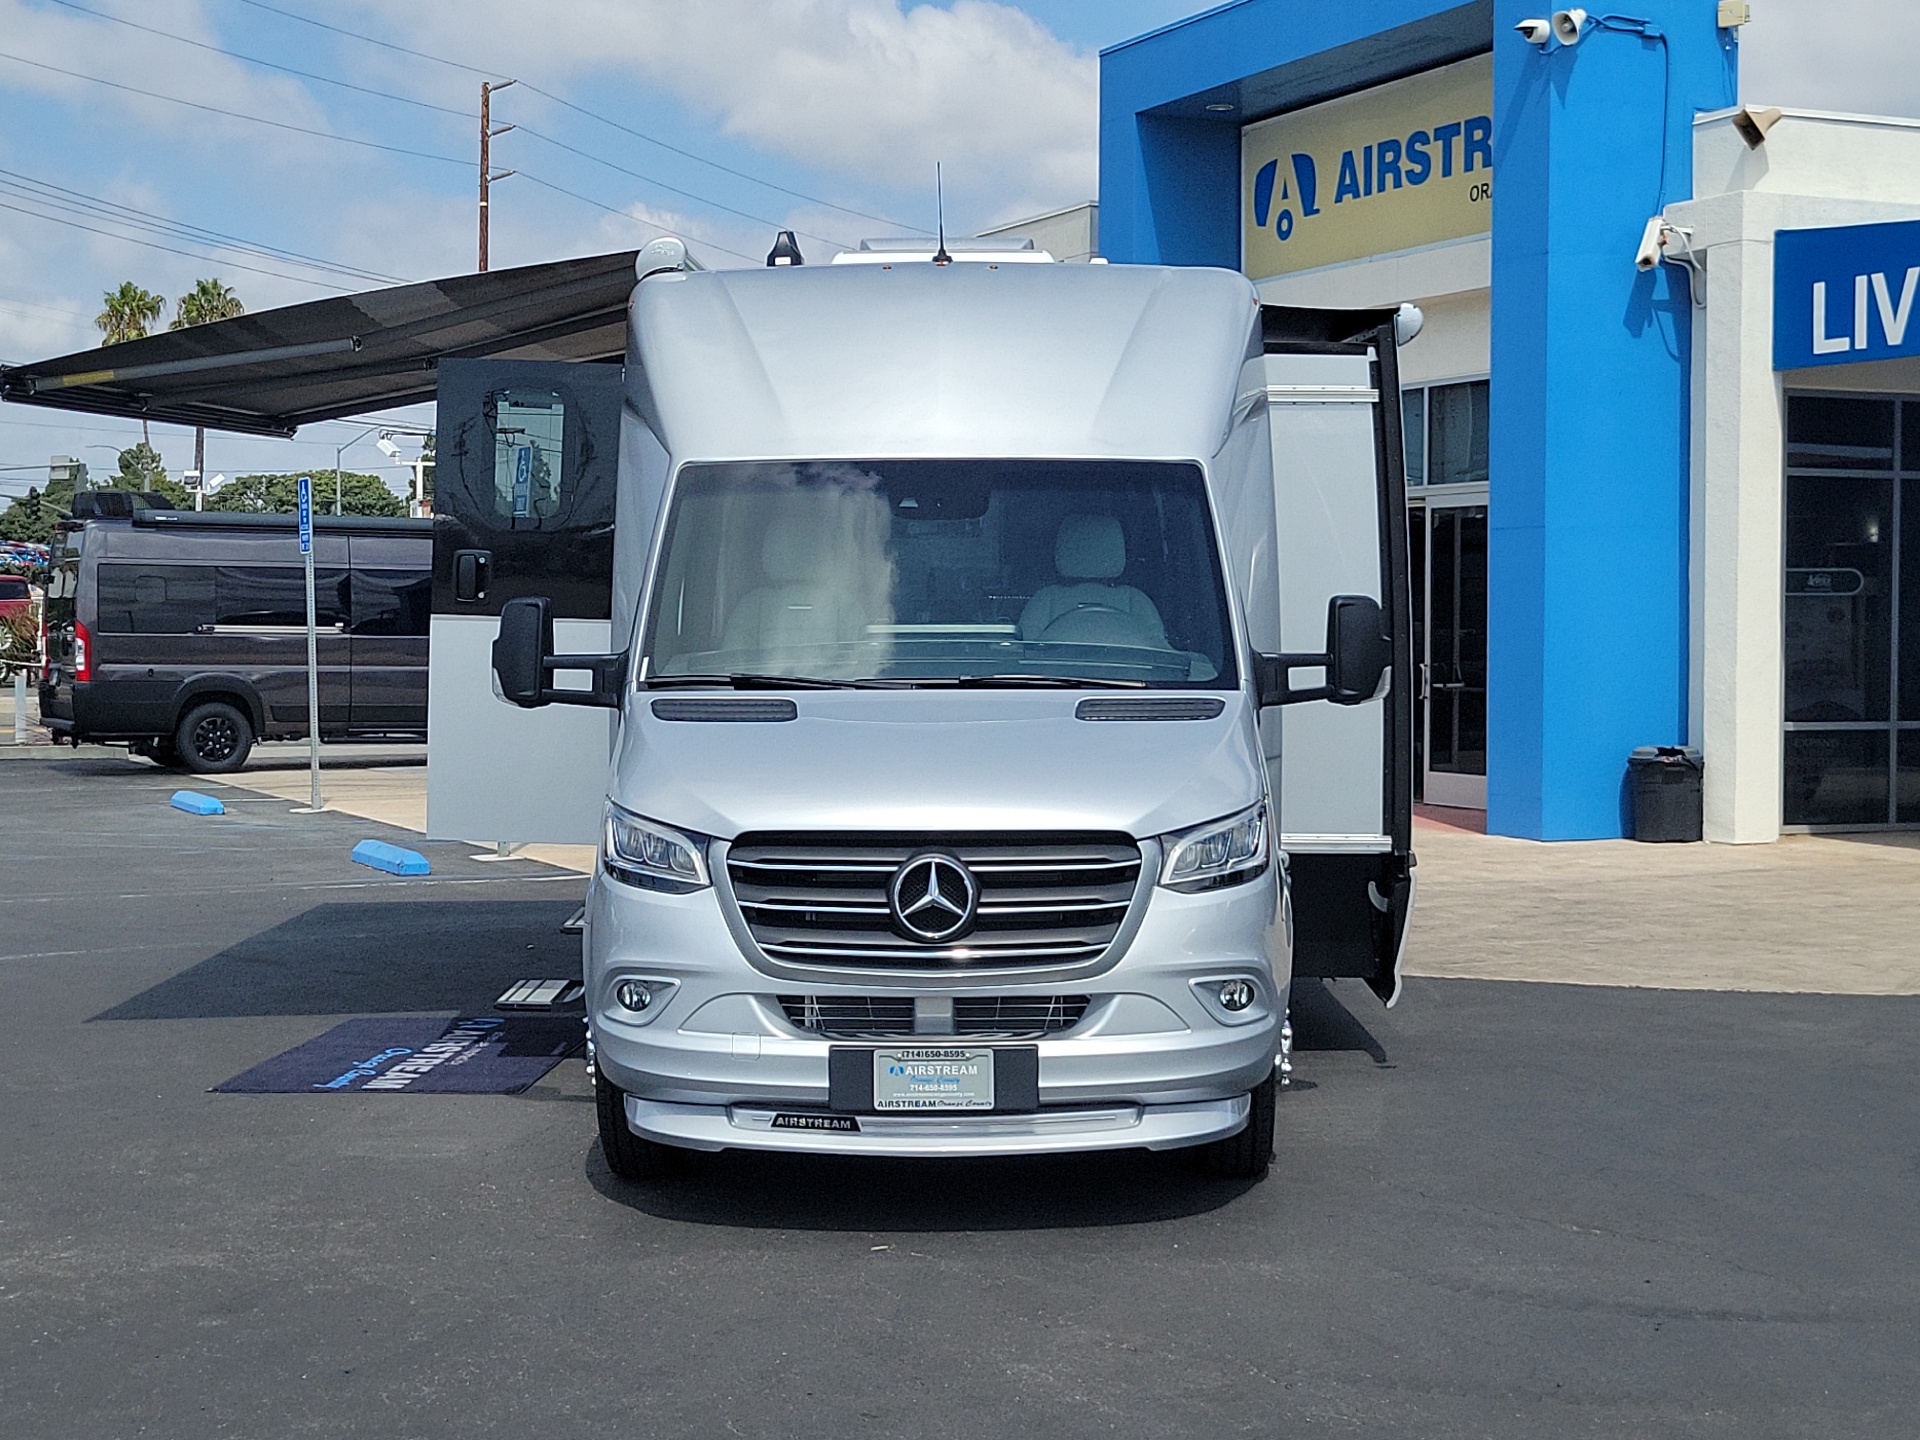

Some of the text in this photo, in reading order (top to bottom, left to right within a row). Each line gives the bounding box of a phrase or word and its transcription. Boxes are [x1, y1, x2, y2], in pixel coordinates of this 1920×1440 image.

[1334, 115, 1492, 204] AIRSTR
[1469, 182, 1492, 202] OR
[1813, 266, 1920, 354] LIV
[361, 1029, 486, 1089] AIRSTREAM
[901, 1050, 966, 1058] (714)650-8595
[905, 1065, 978, 1075] AIRSTREAM
[877, 1100, 937, 1108] AIRSTREAM
[776, 1116, 851, 1129] AIRSTREAM
